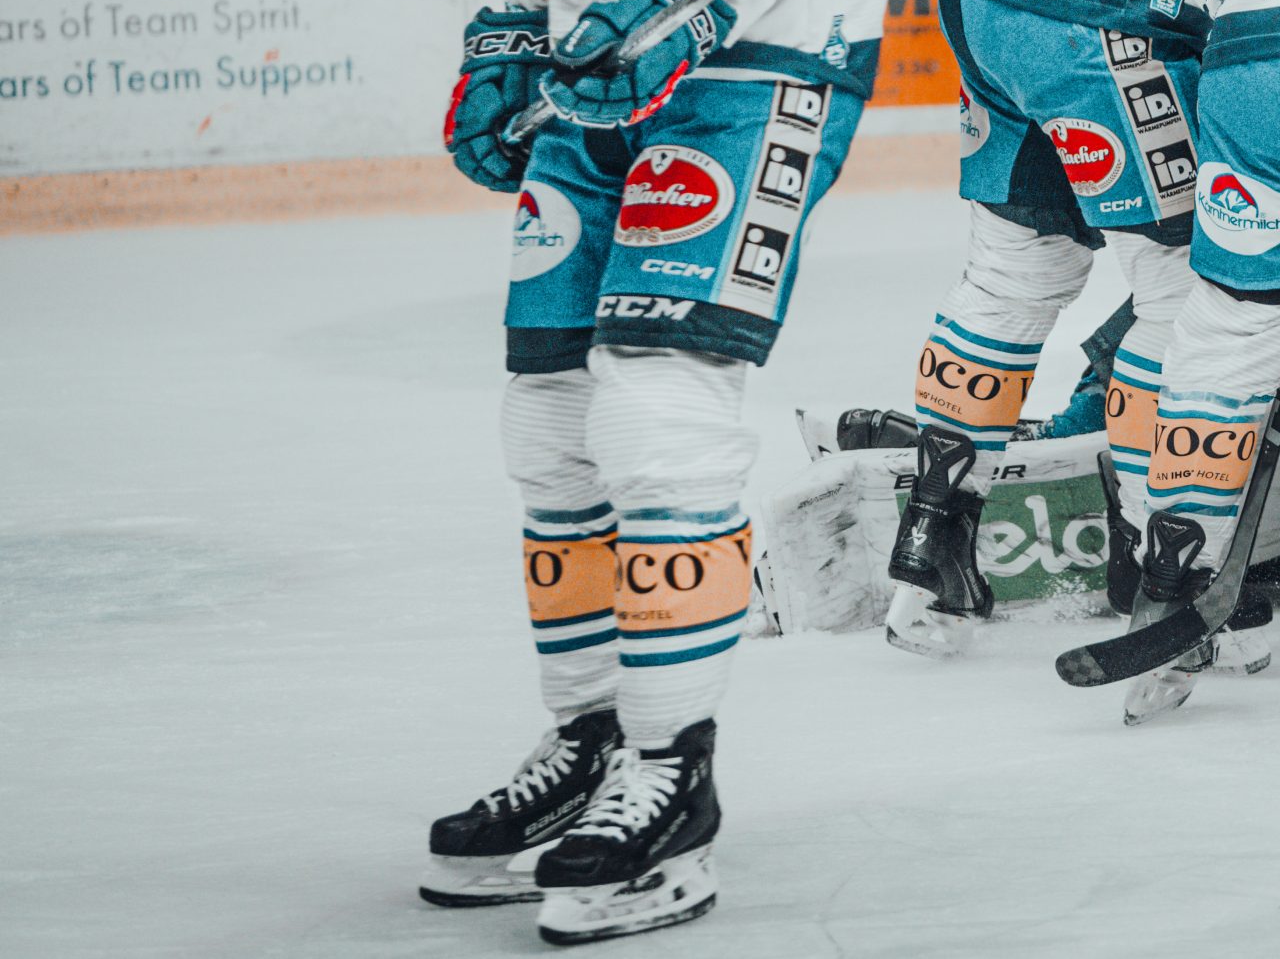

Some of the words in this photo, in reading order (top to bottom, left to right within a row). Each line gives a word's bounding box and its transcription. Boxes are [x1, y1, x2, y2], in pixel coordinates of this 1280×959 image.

[60, 2, 94, 40] of
[105, 4, 198, 37] Team
[213, 0, 310, 40] Spirit.
[64, 59, 96, 96] of
[108, 60, 201, 95] Team
[217, 55, 363, 96] Support.
[1137, 116, 1182, 135] WÄRMEPUMPEN
[1100, 195, 1144, 213] CCM
[640, 258, 715, 280] CCM
[596, 295, 696, 321] CCM
[932, 395, 964, 416] HOTEL
[1155, 472, 1169, 481] AN
[1196, 470, 1230, 483] HOTEL
